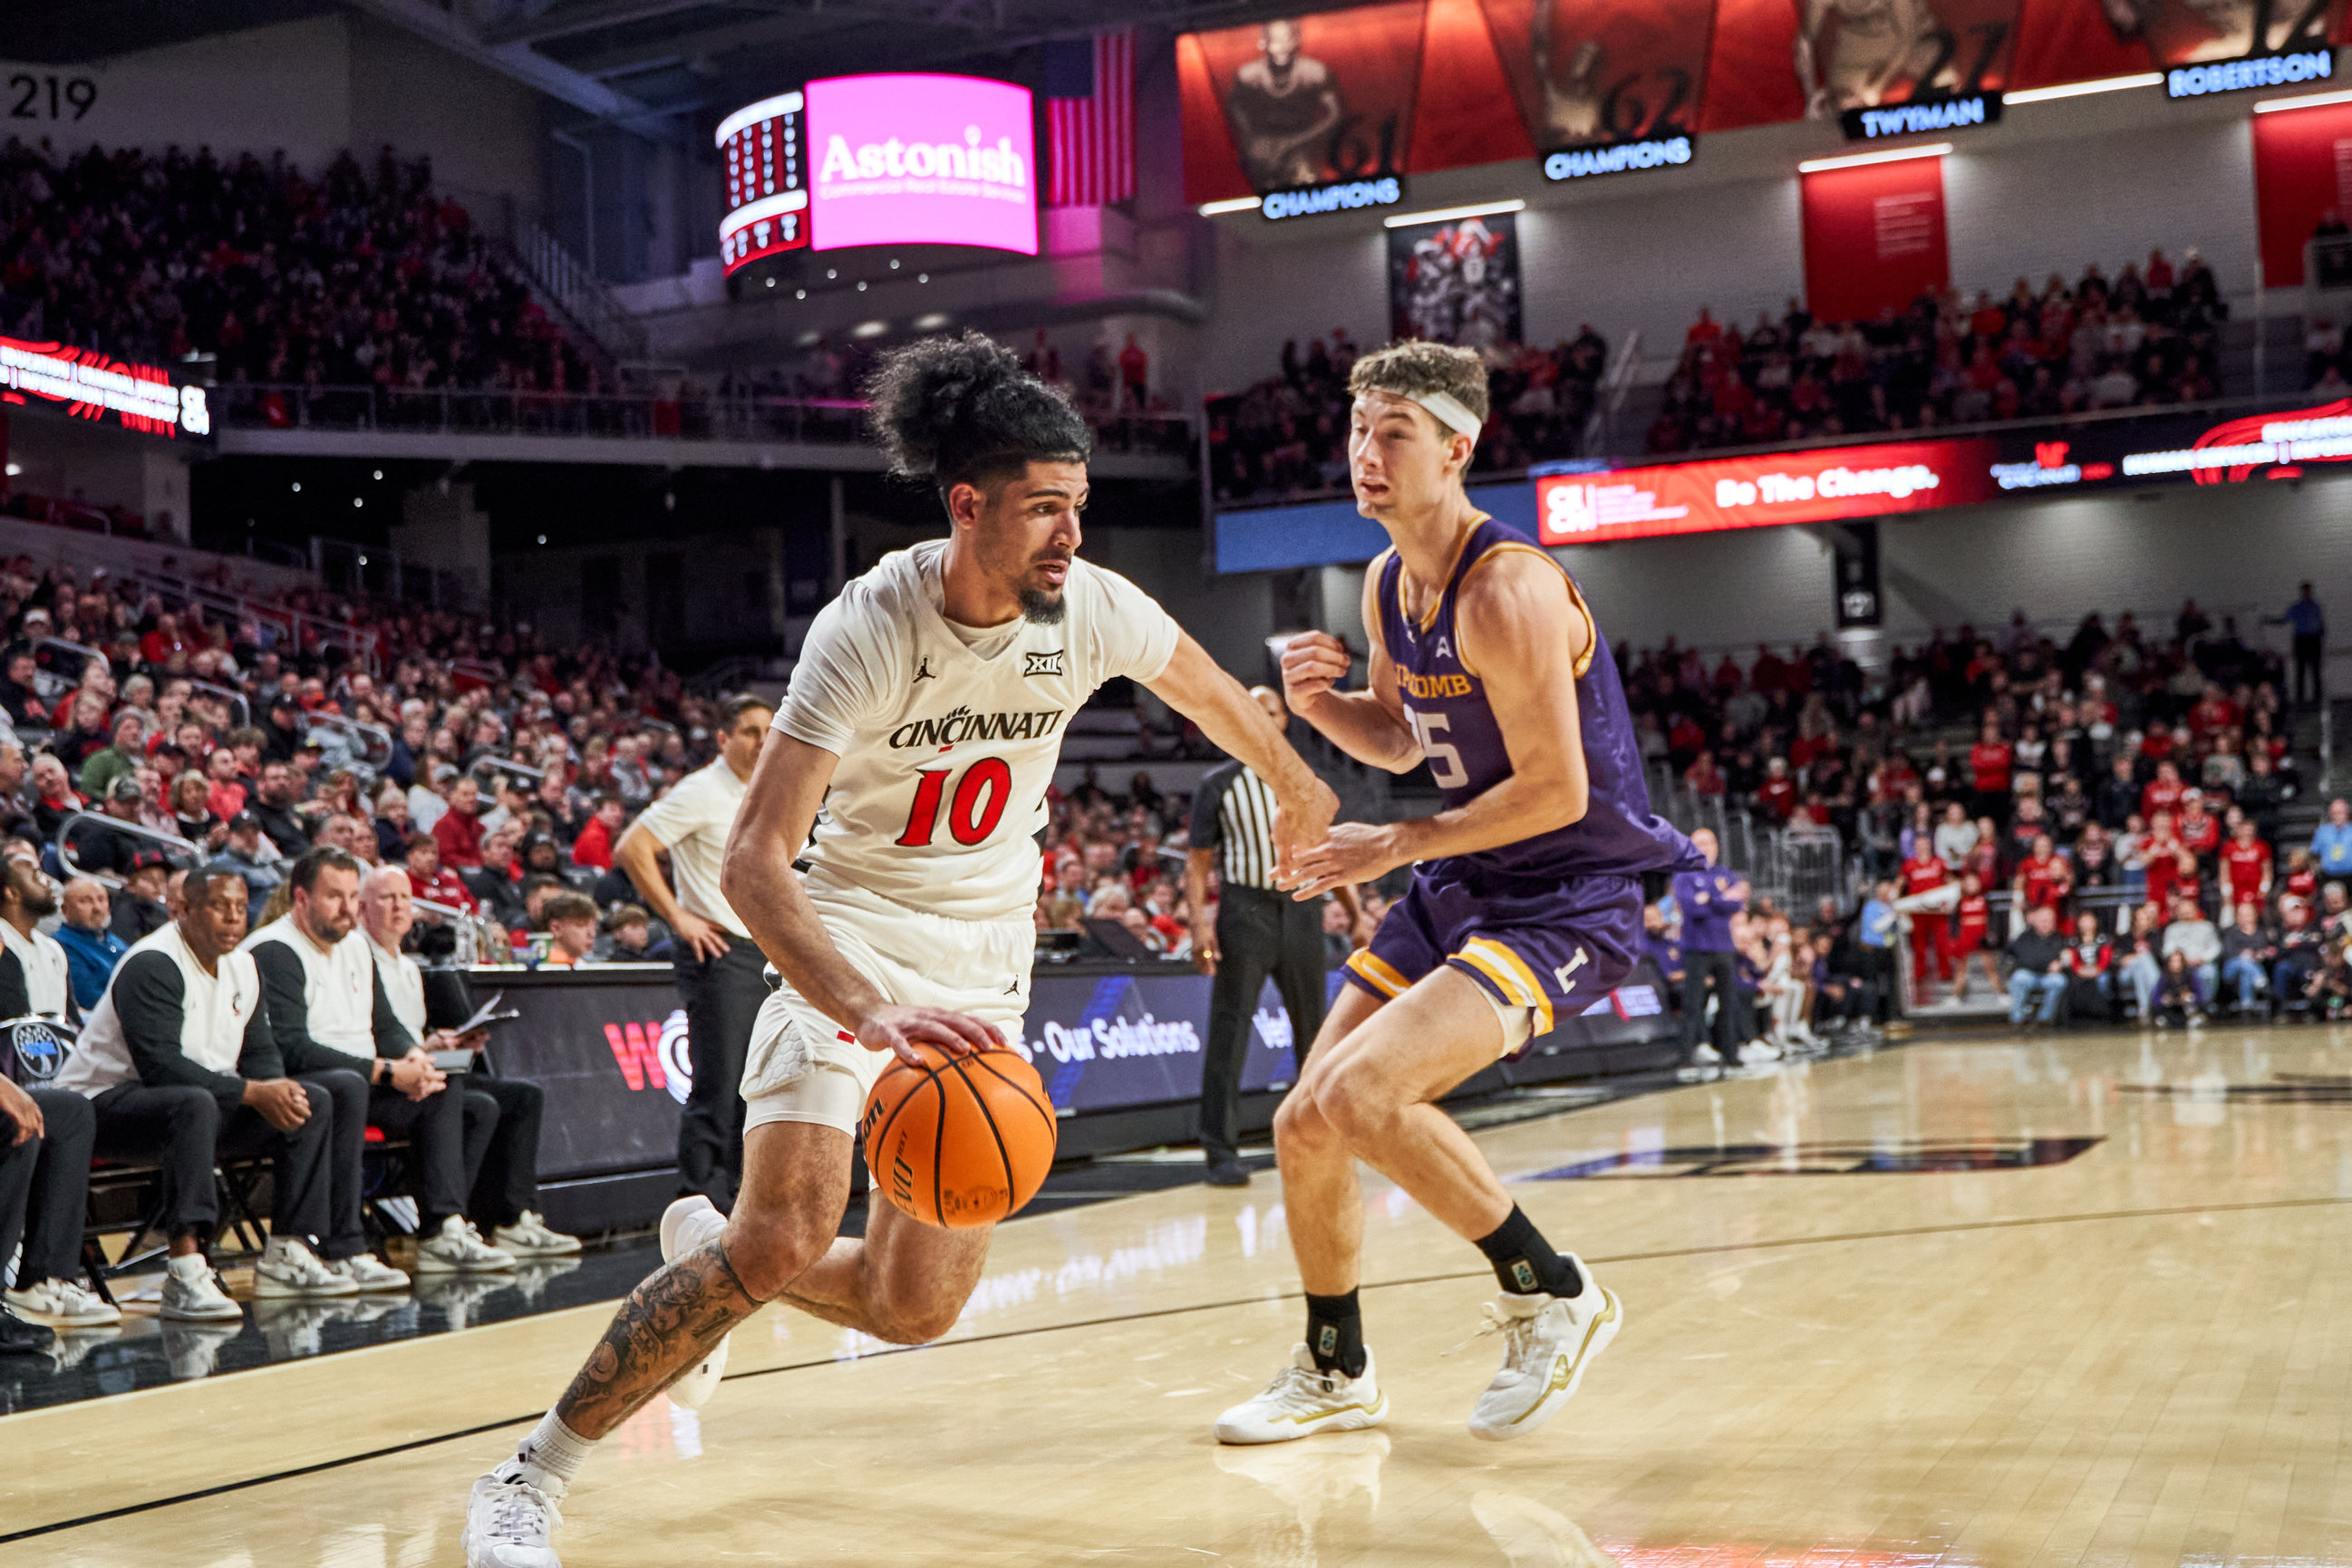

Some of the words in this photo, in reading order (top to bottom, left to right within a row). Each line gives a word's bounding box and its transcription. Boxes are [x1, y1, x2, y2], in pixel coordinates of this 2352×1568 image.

[1912, 21, 2008, 98] 27
[2169, 50, 2331, 97] ROBERTSON
[9, 75, 97, 120] 219
[1861, 97, 1984, 138] TWYMAN
[818, 124, 1026, 188] Astonish
[1544, 136, 1692, 180] CHAMPIONS
[1263, 178, 1400, 219] CHAMPIONS
[1716, 479, 1757, 508] Be
[1757, 472, 1815, 503] The
[1026, 652, 1062, 675] XII
[889, 707, 1065, 750] CINCINNATI
[895, 757, 1012, 847] 10
[1044, 1021, 1096, 1062] Our
[1091, 1012, 1201, 1059] Solutions
